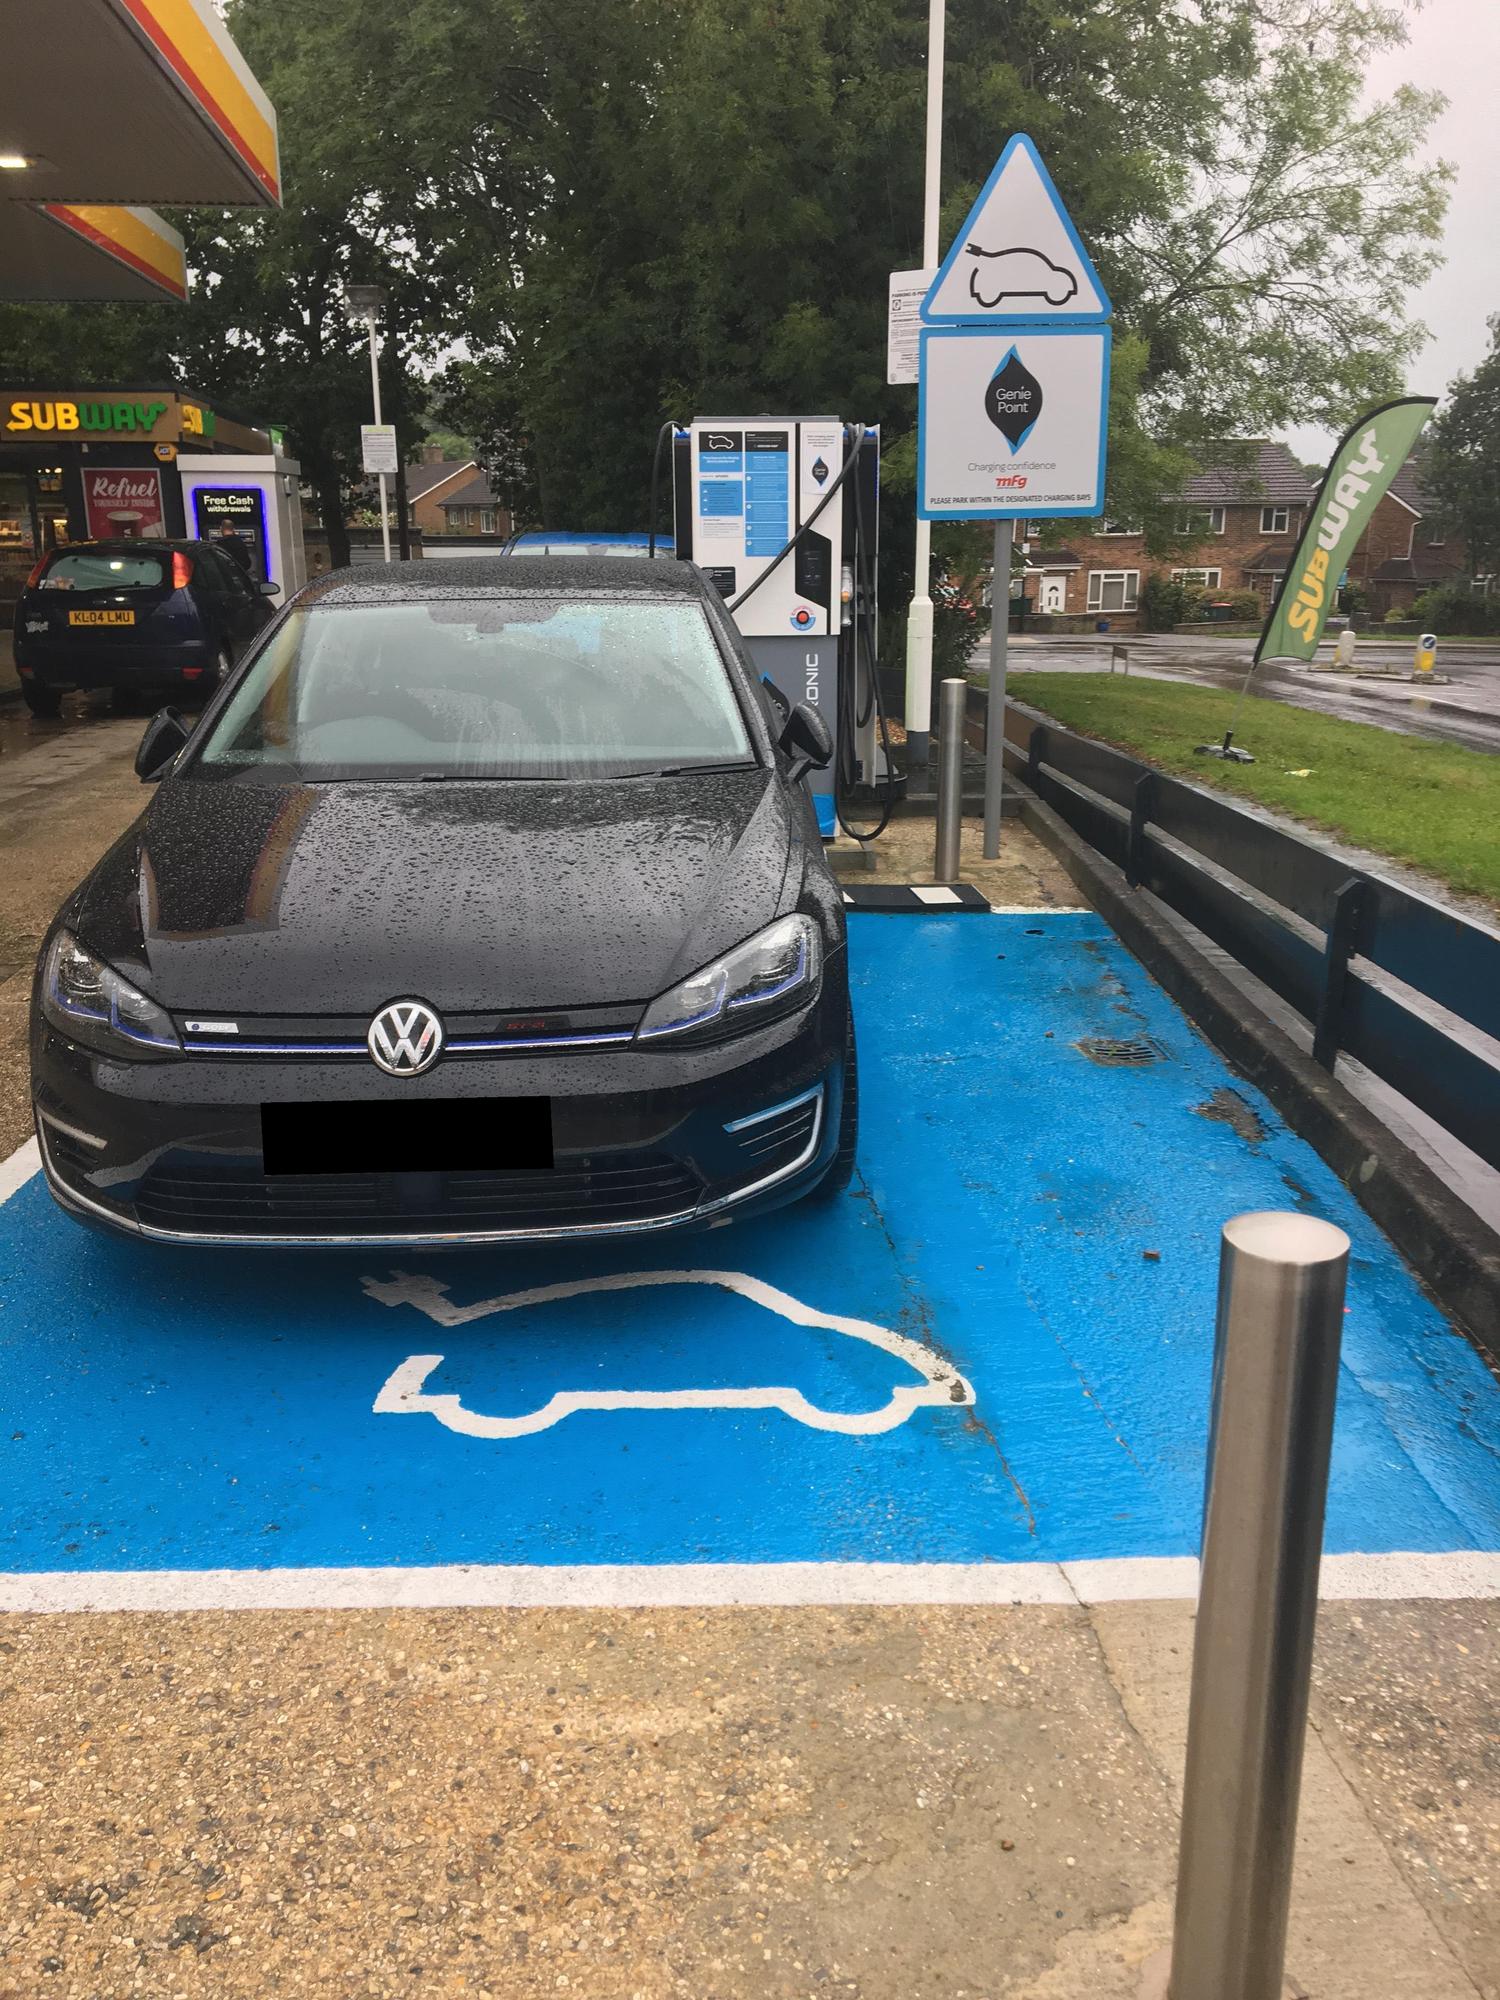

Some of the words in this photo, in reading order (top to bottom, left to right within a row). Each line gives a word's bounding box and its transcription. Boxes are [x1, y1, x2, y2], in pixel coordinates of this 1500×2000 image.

[995, 386, 1032, 400] Genie
[998, 401, 1029, 413] Point
[6, 402, 167, 431] SUBWAY
[967, 461, 1006, 473] Charging
[1007, 460, 1057, 471] confidence
[92, 477, 157, 498] Refuel
[203, 495, 227, 505] Free
[228, 495, 254, 505] Cash
[207, 505, 251, 513] withdrawals
[1288, 428, 1385, 644] SUBWAY
[73, 612, 104, 623] KL04
[107, 612, 131, 623] LMU
